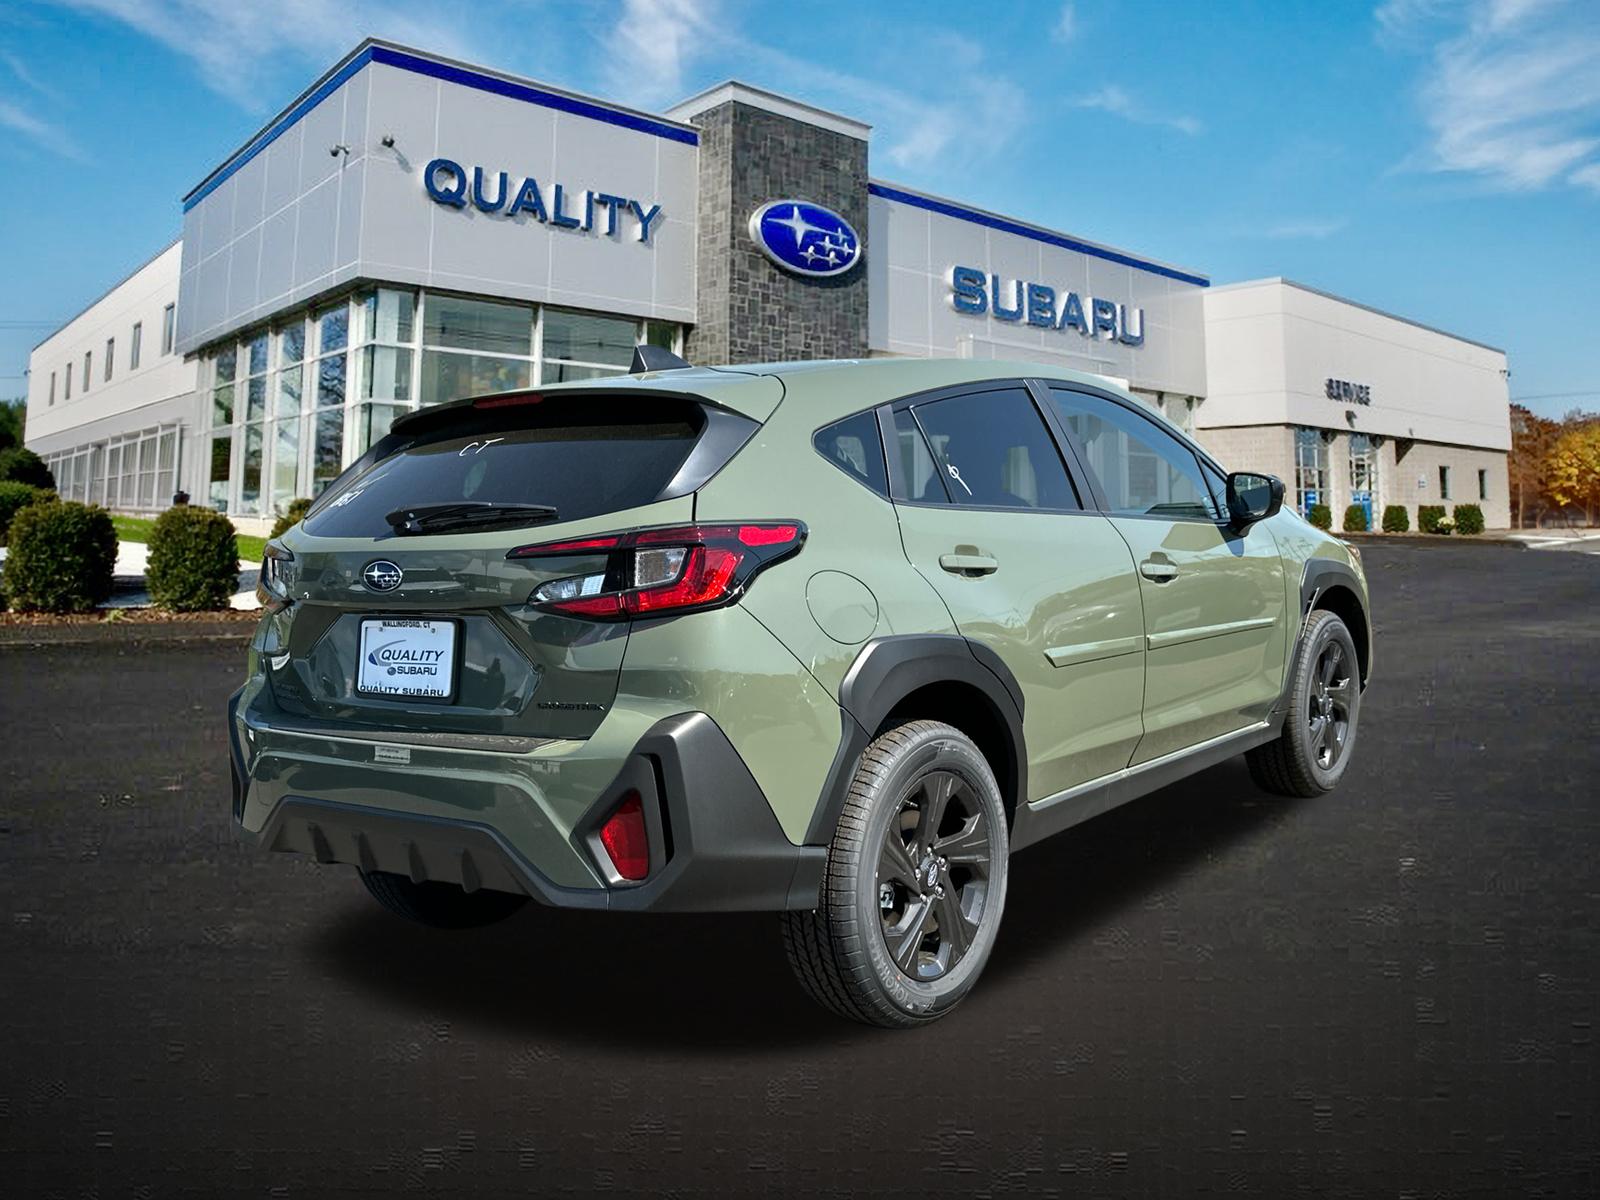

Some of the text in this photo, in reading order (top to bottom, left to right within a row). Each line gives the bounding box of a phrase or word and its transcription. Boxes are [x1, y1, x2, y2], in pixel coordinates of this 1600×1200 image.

[424, 158, 662, 243] QUALITY
[950, 265, 1146, 348] SUBARU
[381, 649, 444, 662] QUALITY
[397, 666, 438, 676] SUBARU
[360, 684, 444, 697] QUALITY SUBARU
